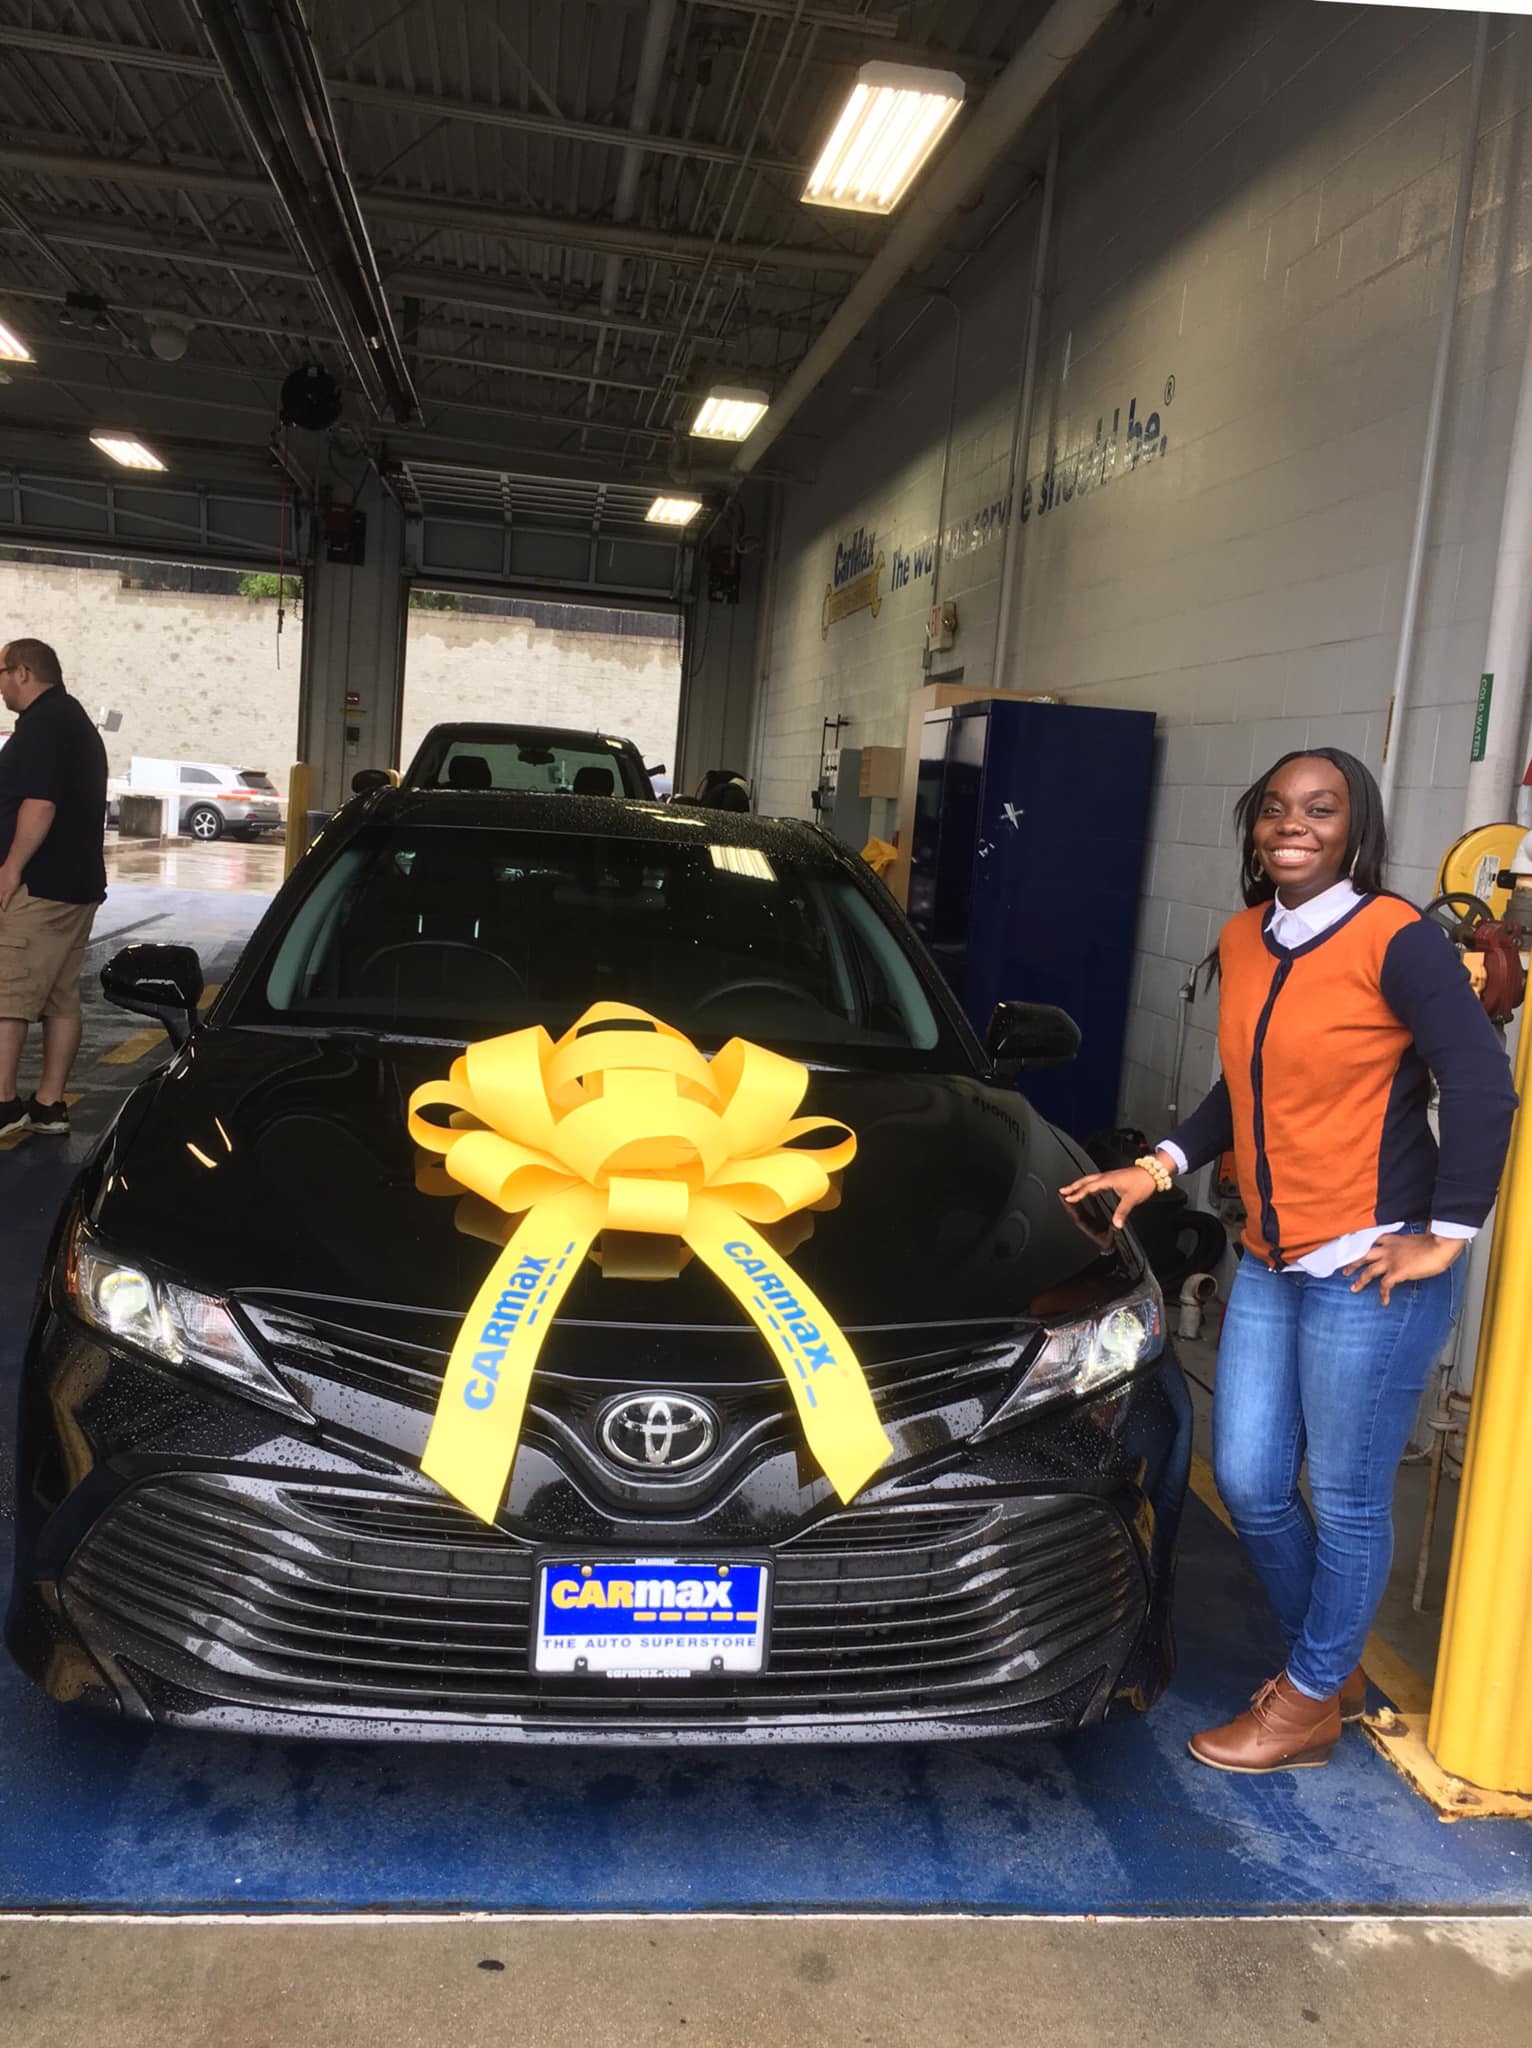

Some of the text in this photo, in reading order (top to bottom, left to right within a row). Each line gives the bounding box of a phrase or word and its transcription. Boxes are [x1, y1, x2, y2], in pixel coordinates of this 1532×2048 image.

[890, 543, 910, 592] The
[973, 480, 1033, 552] servie
[1472, 714, 1483, 757] WATER
[723, 1241, 836, 1373] CARmax
[463, 1254, 551, 1411] CARmax
[551, 1579, 733, 1609] CARmax
[544, 1637, 757, 1649] THE AUTO SUPERSTORE
[606, 1668, 691, 1678] carmax.com
